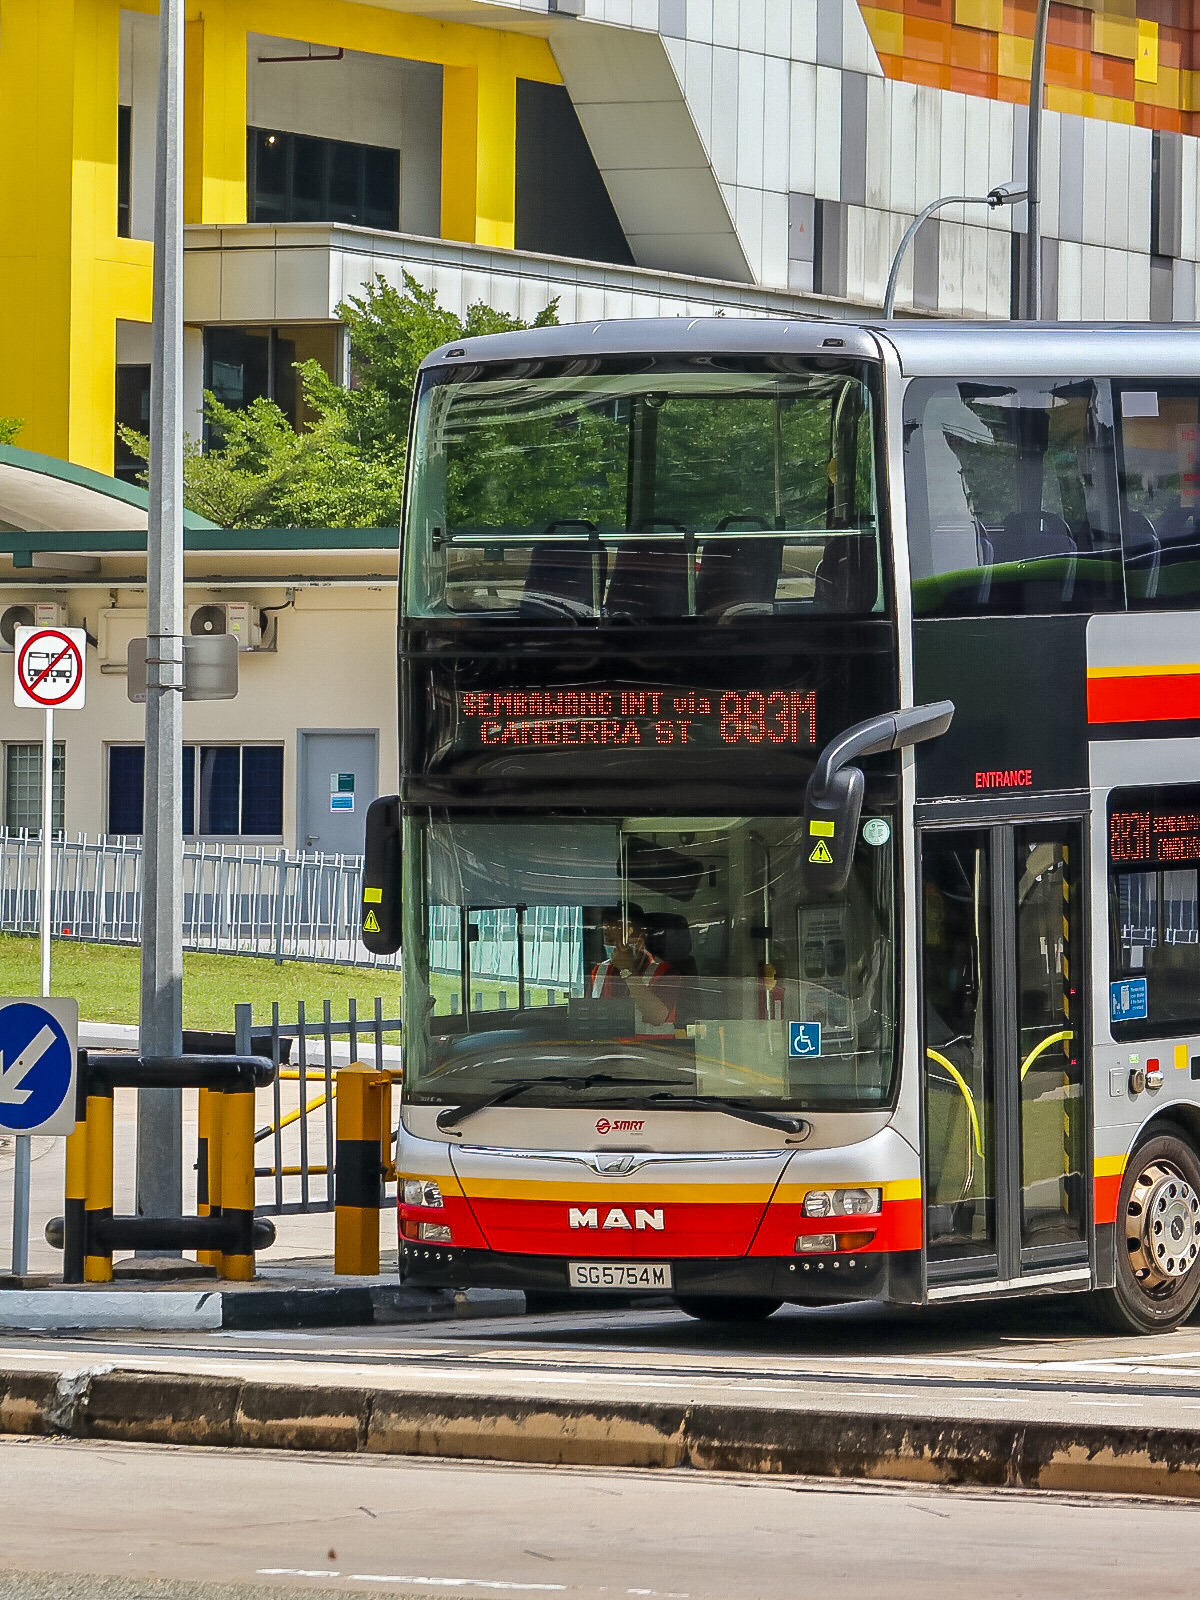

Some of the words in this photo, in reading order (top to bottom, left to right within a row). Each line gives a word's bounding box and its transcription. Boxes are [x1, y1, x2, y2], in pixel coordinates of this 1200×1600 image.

[463, 692, 612, 716] SEMBAWANG
[621, 691, 664, 715] INT
[673, 691, 711, 714] via
[720, 691, 817, 743] 883M
[480, 720, 642, 744] CANBERRA
[655, 720, 692, 744] ST
[975, 769, 1032, 788] ENTRANCE
[611, 1120, 646, 1131] SMRT
[568, 1207, 665, 1231] MAN
[576, 1265, 665, 1286] SG5754M
